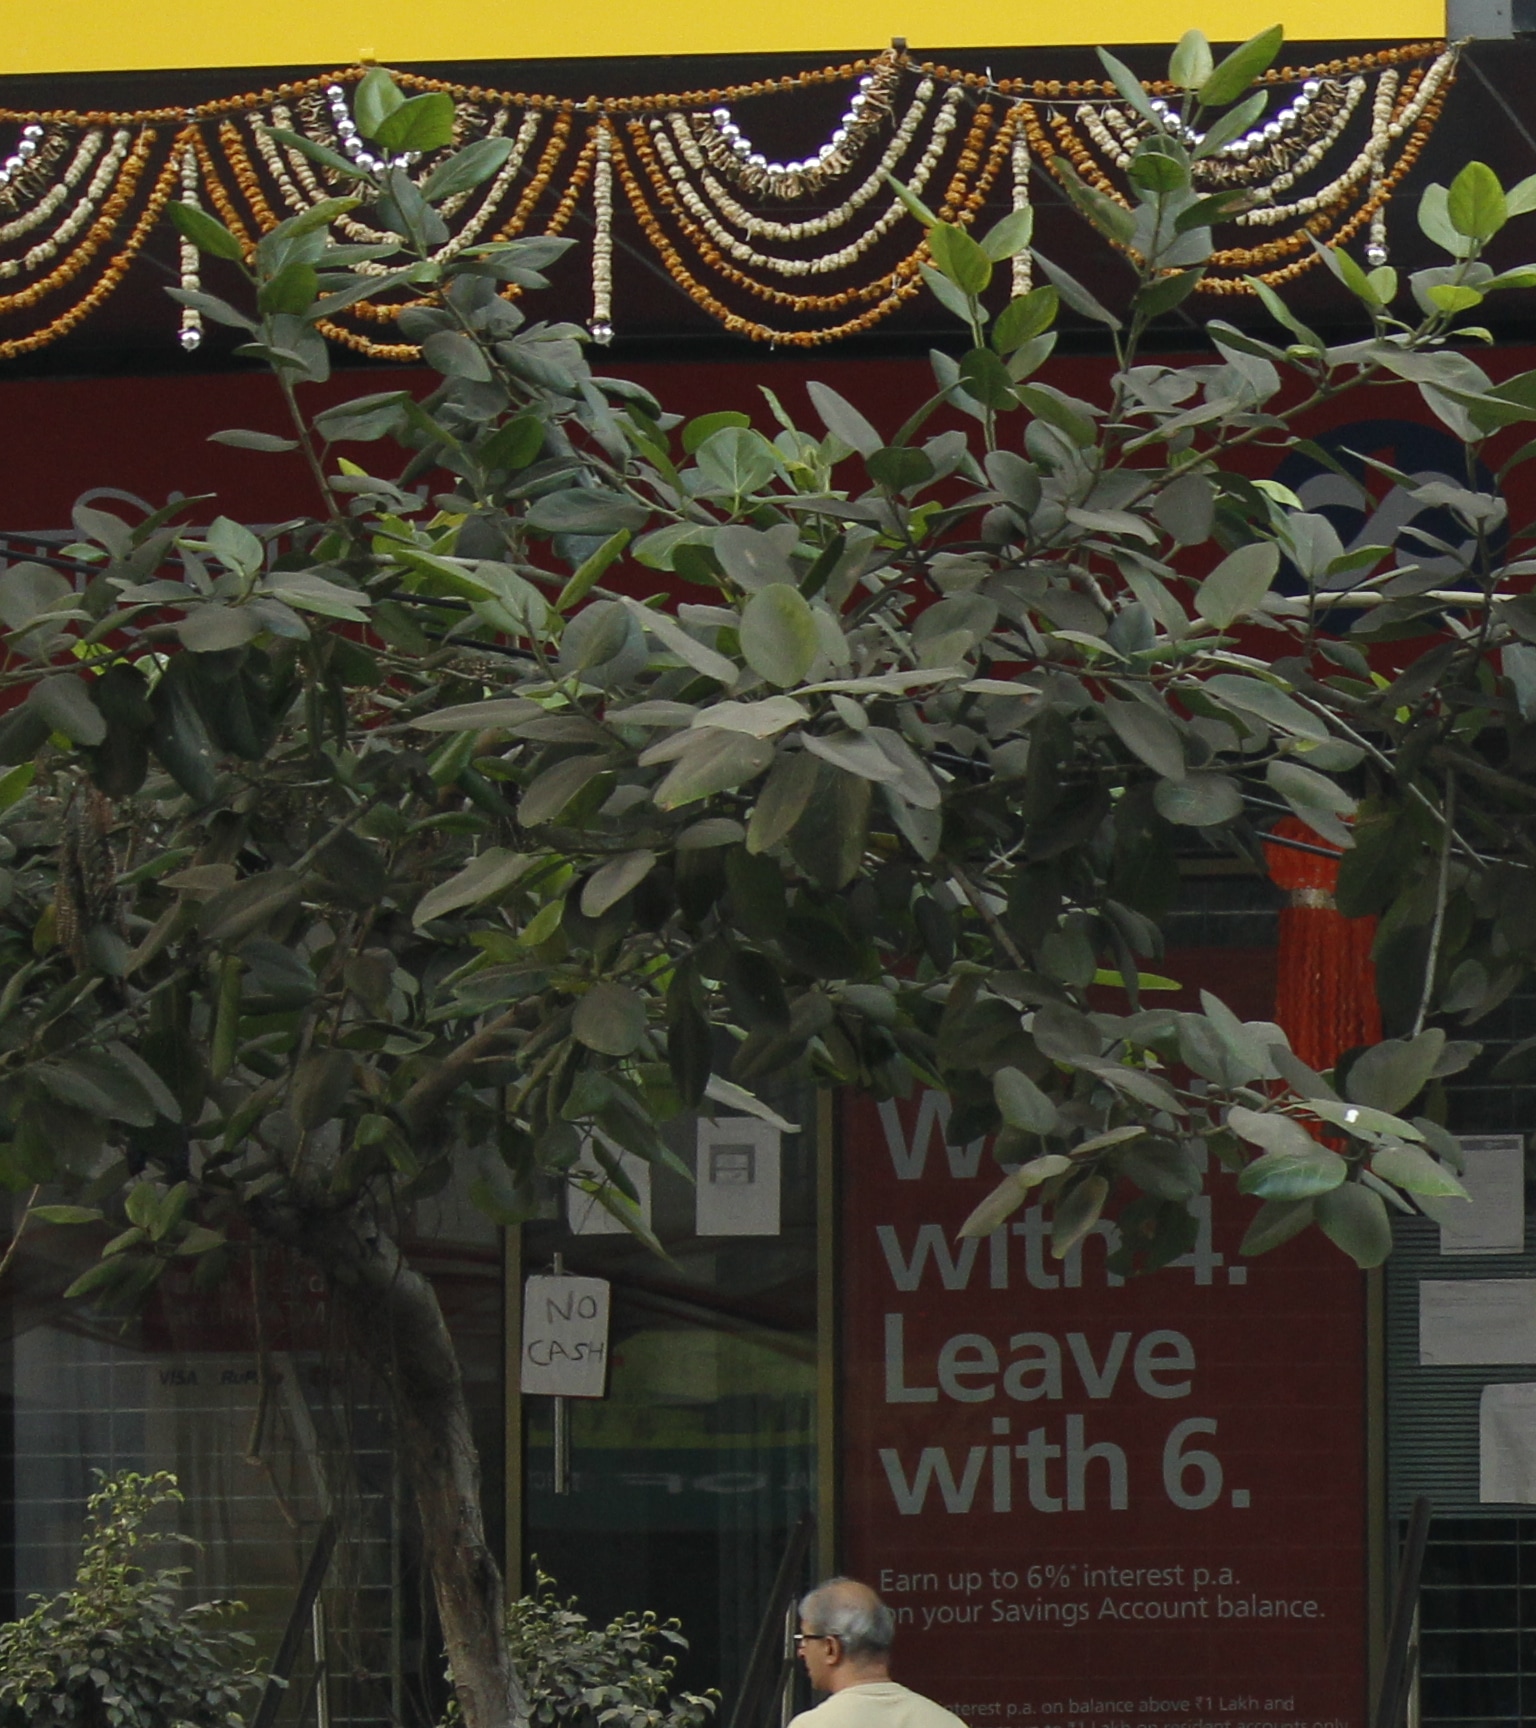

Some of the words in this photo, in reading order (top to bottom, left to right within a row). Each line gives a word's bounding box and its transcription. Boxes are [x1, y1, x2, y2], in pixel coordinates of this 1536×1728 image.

[546, 1290, 597, 1324] NO
[527, 1339, 604, 1366] CASH
[884, 1312, 1197, 1403] Leave
[878, 1414, 1128, 1514] with
[1162, 1416, 1250, 1510] 6.
[880, 1568, 939, 1592] Earn
[948, 1572, 983, 1596] up
[990, 1568, 1019, 1590] to
[1083, 1564, 1185, 1588] interest
[1193, 1569, 1241, 1592] p.a.
[922, 1605, 984, 1630] your
[991, 1598, 1090, 1627] Savings
[1097, 1597, 1210, 1621] Account
[1217, 1593, 1326, 1619] balance.
[1006, 1702, 1037, 1718] p.a.
[1041, 1702, 1065, 1715] on
[1068, 1697, 1134, 1714] balance
[1138, 1697, 1191, 1713] above
[1218, 1695, 1260, 1711] Lakh
[1263, 1695, 1295, 1711] and
